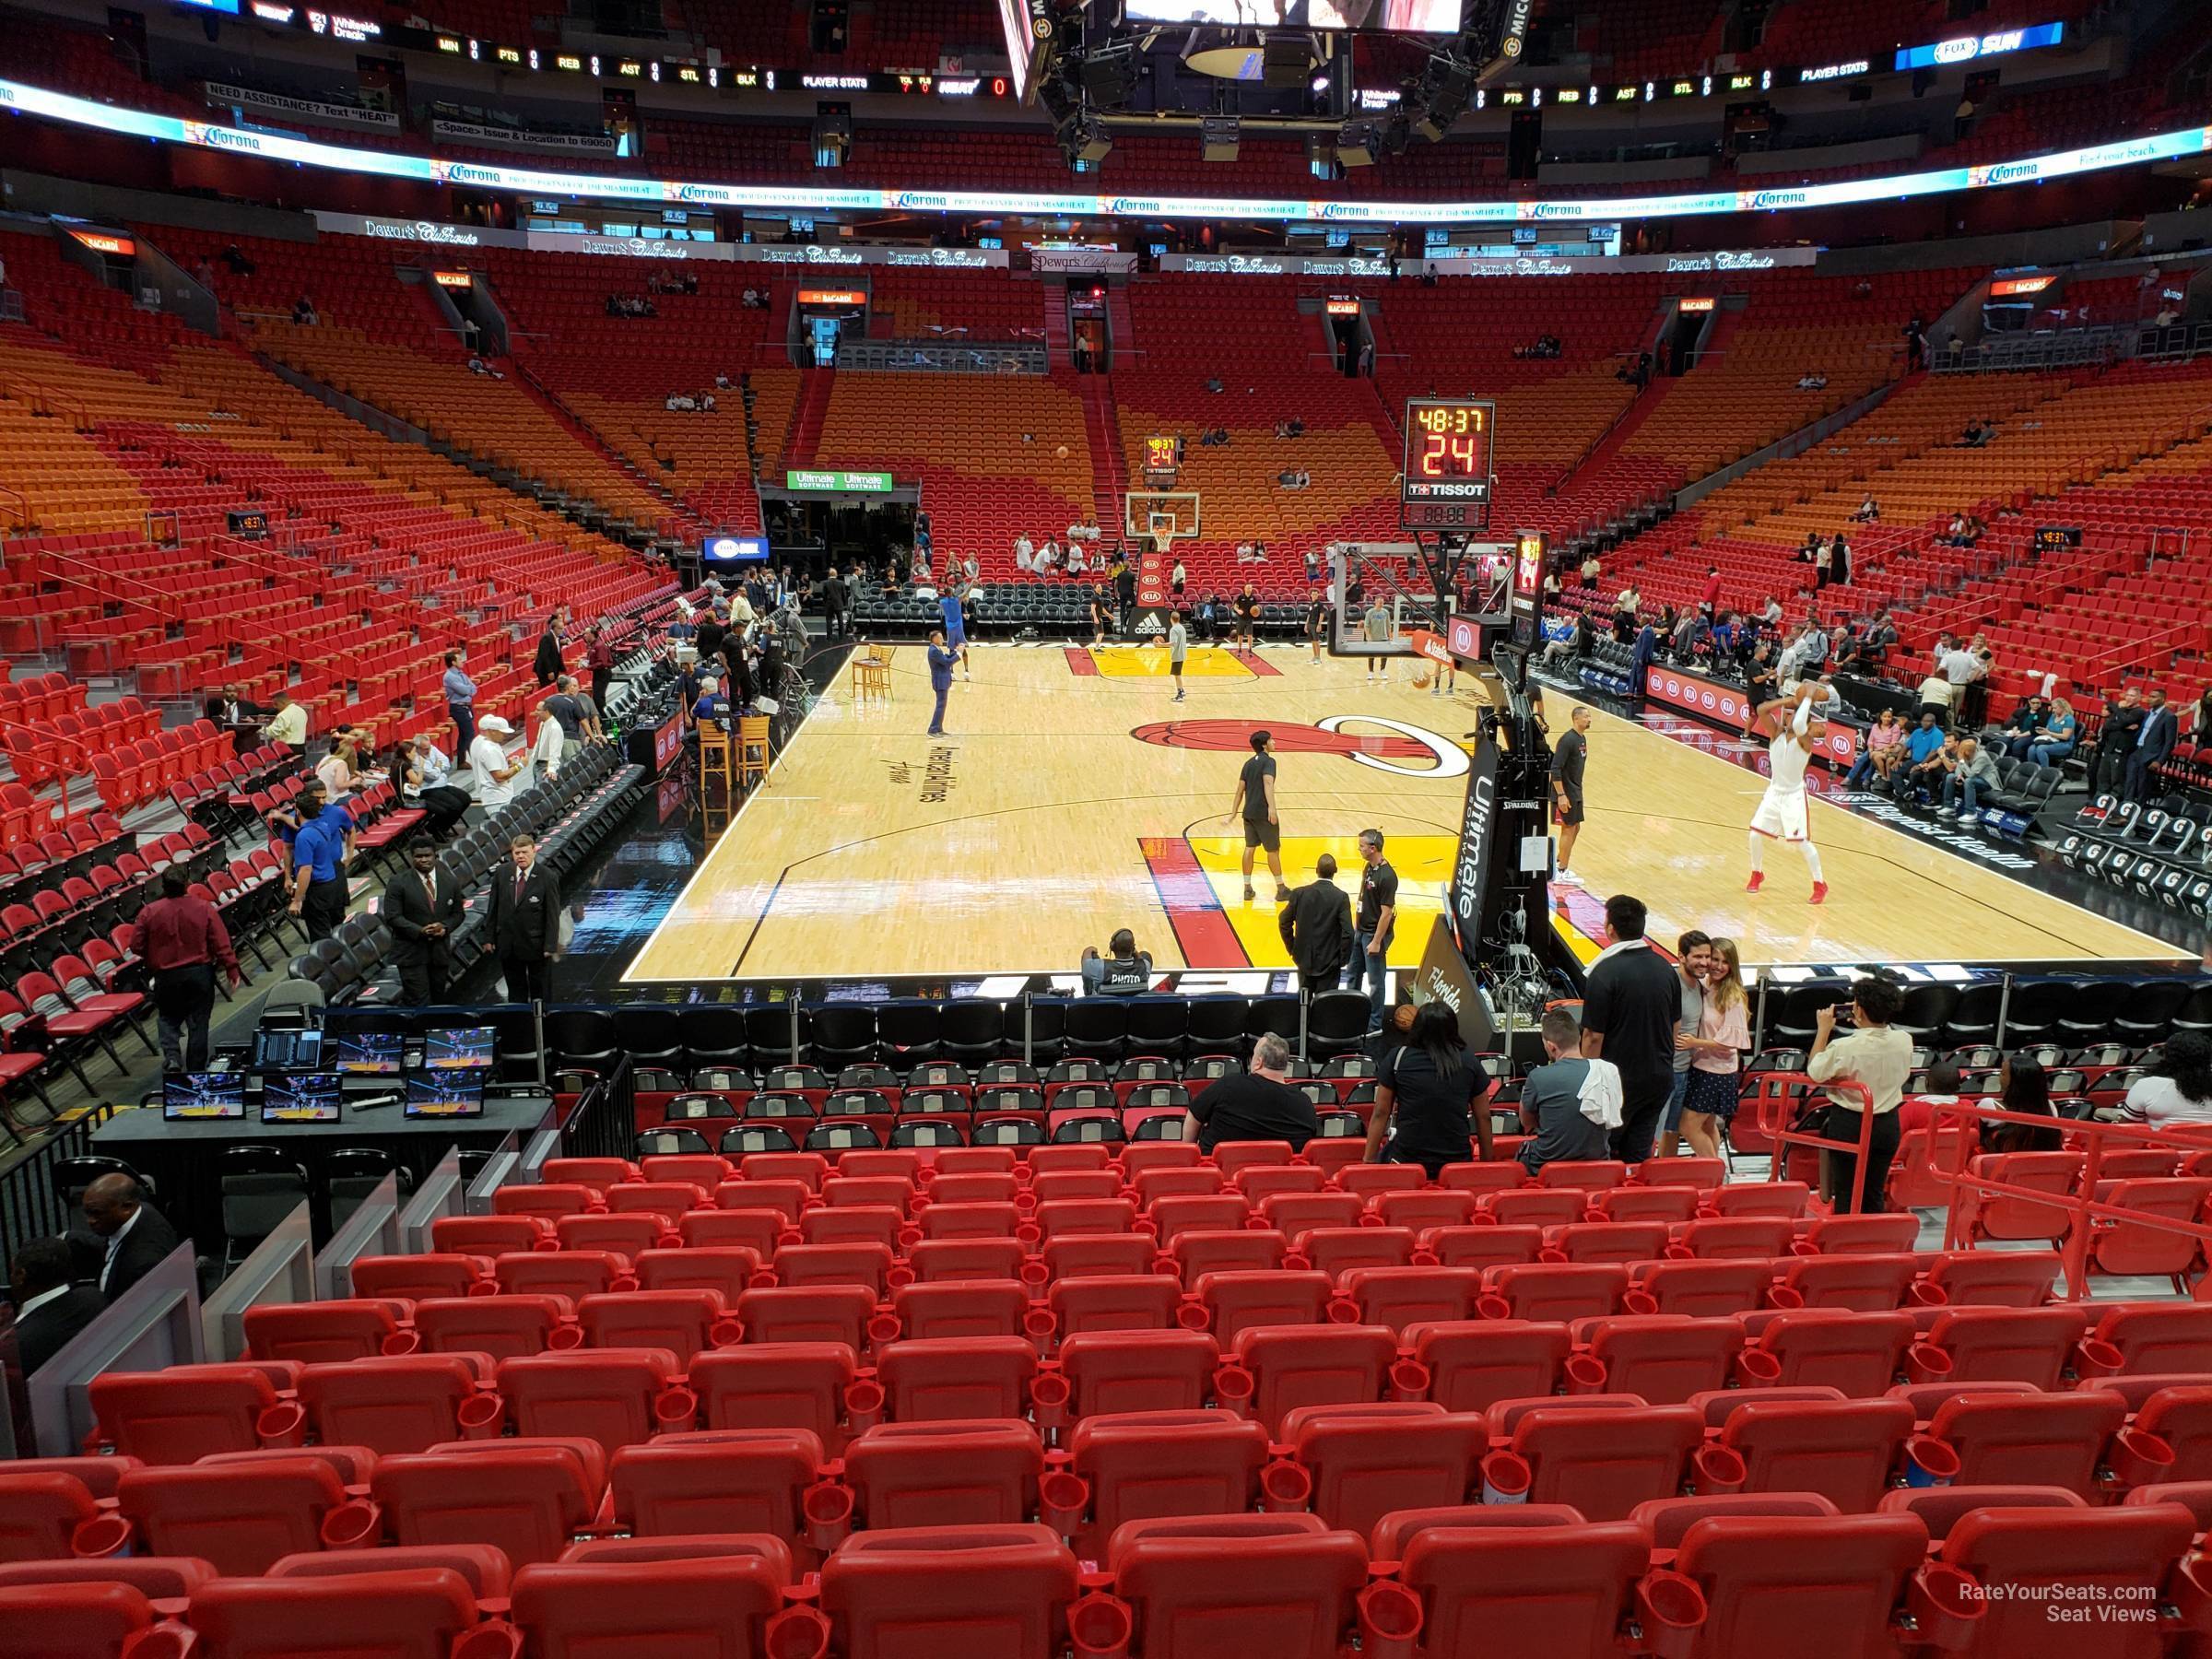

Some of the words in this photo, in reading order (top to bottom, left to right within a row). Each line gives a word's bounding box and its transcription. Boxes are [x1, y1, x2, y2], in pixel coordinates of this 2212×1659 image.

[332, 16, 381, 34] Whiteside
[333, 28, 365, 41] Dragic
[1981, 31, 2022, 53] SUN
[439, 38, 459, 53] MIN
[500, 49, 519, 62] PTS
[559, 57, 580, 70] REB
[620, 63, 641, 76] AST
[680, 69, 700, 82] STL
[1802, 65, 1839, 82] PLAYER
[1841, 61, 1868, 77] STATS
[737, 74, 757, 86] BLK
[803, 76, 837, 88] PLAYER
[839, 76, 868, 89] STATS
[995, 79, 1005, 95] 0
[1732, 76, 1751, 88] BLK
[923, 84, 928, 93] 0
[1559, 90, 1579, 102] REB
[1617, 88, 1636, 100] AST
[1675, 84, 1692, 95] STL
[210, 83, 240, 100] NEED
[243, 90, 321, 113] ASSISTANCE?
[324, 107, 348, 118] Text
[1503, 91, 1523, 104] PTS
[205, 126, 261, 150] Corona
[436, 122, 481, 135] <Space>
[483, 124, 510, 138] Issue
[512, 132, 520, 141] &
[522, 133, 566, 145] Location
[568, 135, 579, 146] to
[450, 163, 501, 183] Corona
[1988, 163, 2038, 183] Corona
[679, 184, 730, 200] Corona
[1754, 192, 1806, 207] Corona
[900, 193, 947, 207] Corona
[1113, 198, 1159, 213] Corona
[1324, 204, 1369, 218] Corona
[1534, 203, 1582, 218] Corona
[366, 220, 415, 240] Dewar's
[582, 239, 628, 255] Dewar's
[761, 248, 804, 264] Dewar's
[888, 251, 929, 265] Dewar's
[1041, 255, 1080, 268] Dewar's
[1186, 257, 1227, 272] Dewar's
[1471, 263, 1512, 276] Dewar's
[1666, 257, 1712, 273] Dewar's
[1418, 409, 1482, 433] 48:37
[1148, 439, 1174, 451] 48:37
[1151, 449, 1171, 466] 24
[1422, 434, 1475, 476] 24
[796, 472, 835, 483] Ultimate
[844, 473, 883, 485] Ultimate
[1430, 484, 1486, 497] TISSOT
[1135, 626, 1167, 635] adidas
[1457, 629, 1468, 647] KIA
[1835, 738, 1847, 752] KIA
[1502, 800, 1540, 810] SPALDING
[2120, 802, 2134, 817] G
[1985, 811, 2004, 824] ONE
[2147, 810, 2161, 824] G
[2173, 818, 2187, 833] G
[1860, 805, 1955, 836] Baptist
[1935, 835, 2038, 869] Health
[2065, 836, 2079, 850] G
[1459, 775, 1492, 919] Ultimate
[2087, 844, 2102, 859] G
[2113, 853, 2129, 867] G
[2137, 862, 2154, 877] G
[2165, 871, 2182, 888] G
[2194, 881, 2210, 898] G
[1428, 965, 1461, 1014] Florida
